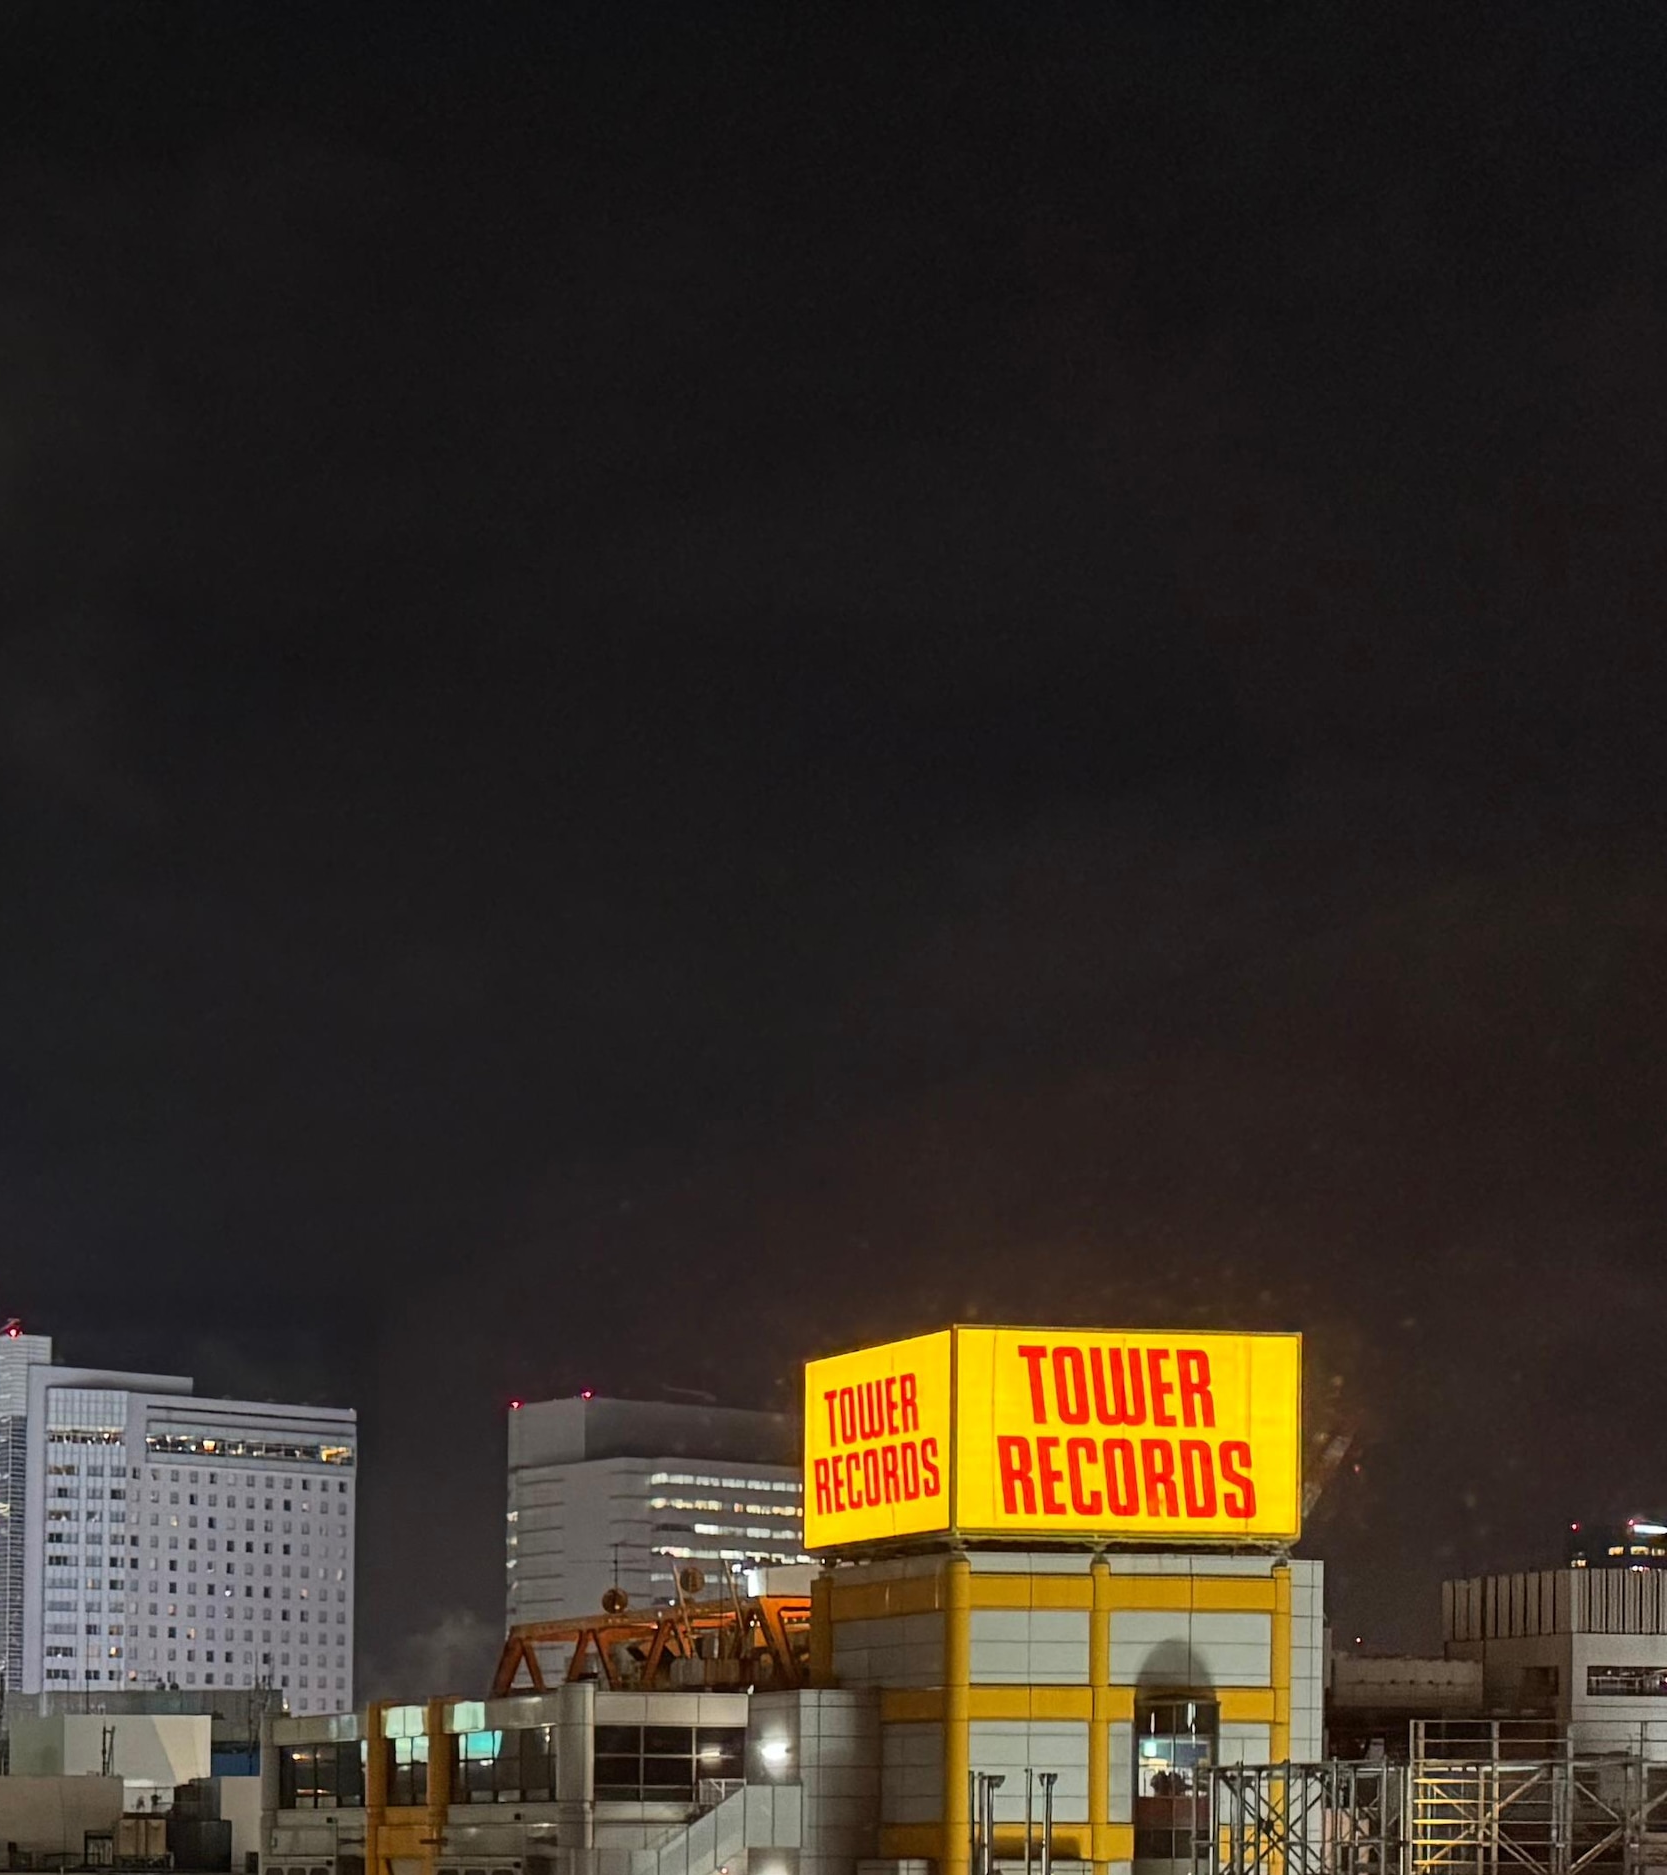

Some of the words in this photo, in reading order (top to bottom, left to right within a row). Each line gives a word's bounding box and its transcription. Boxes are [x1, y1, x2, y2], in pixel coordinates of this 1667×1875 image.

[824, 1372, 919, 1447] TOWER
[1018, 1344, 1216, 1428] TOWER
[814, 1438, 941, 1515] RECORDS
[997, 1435, 1258, 1519] RECORDS
